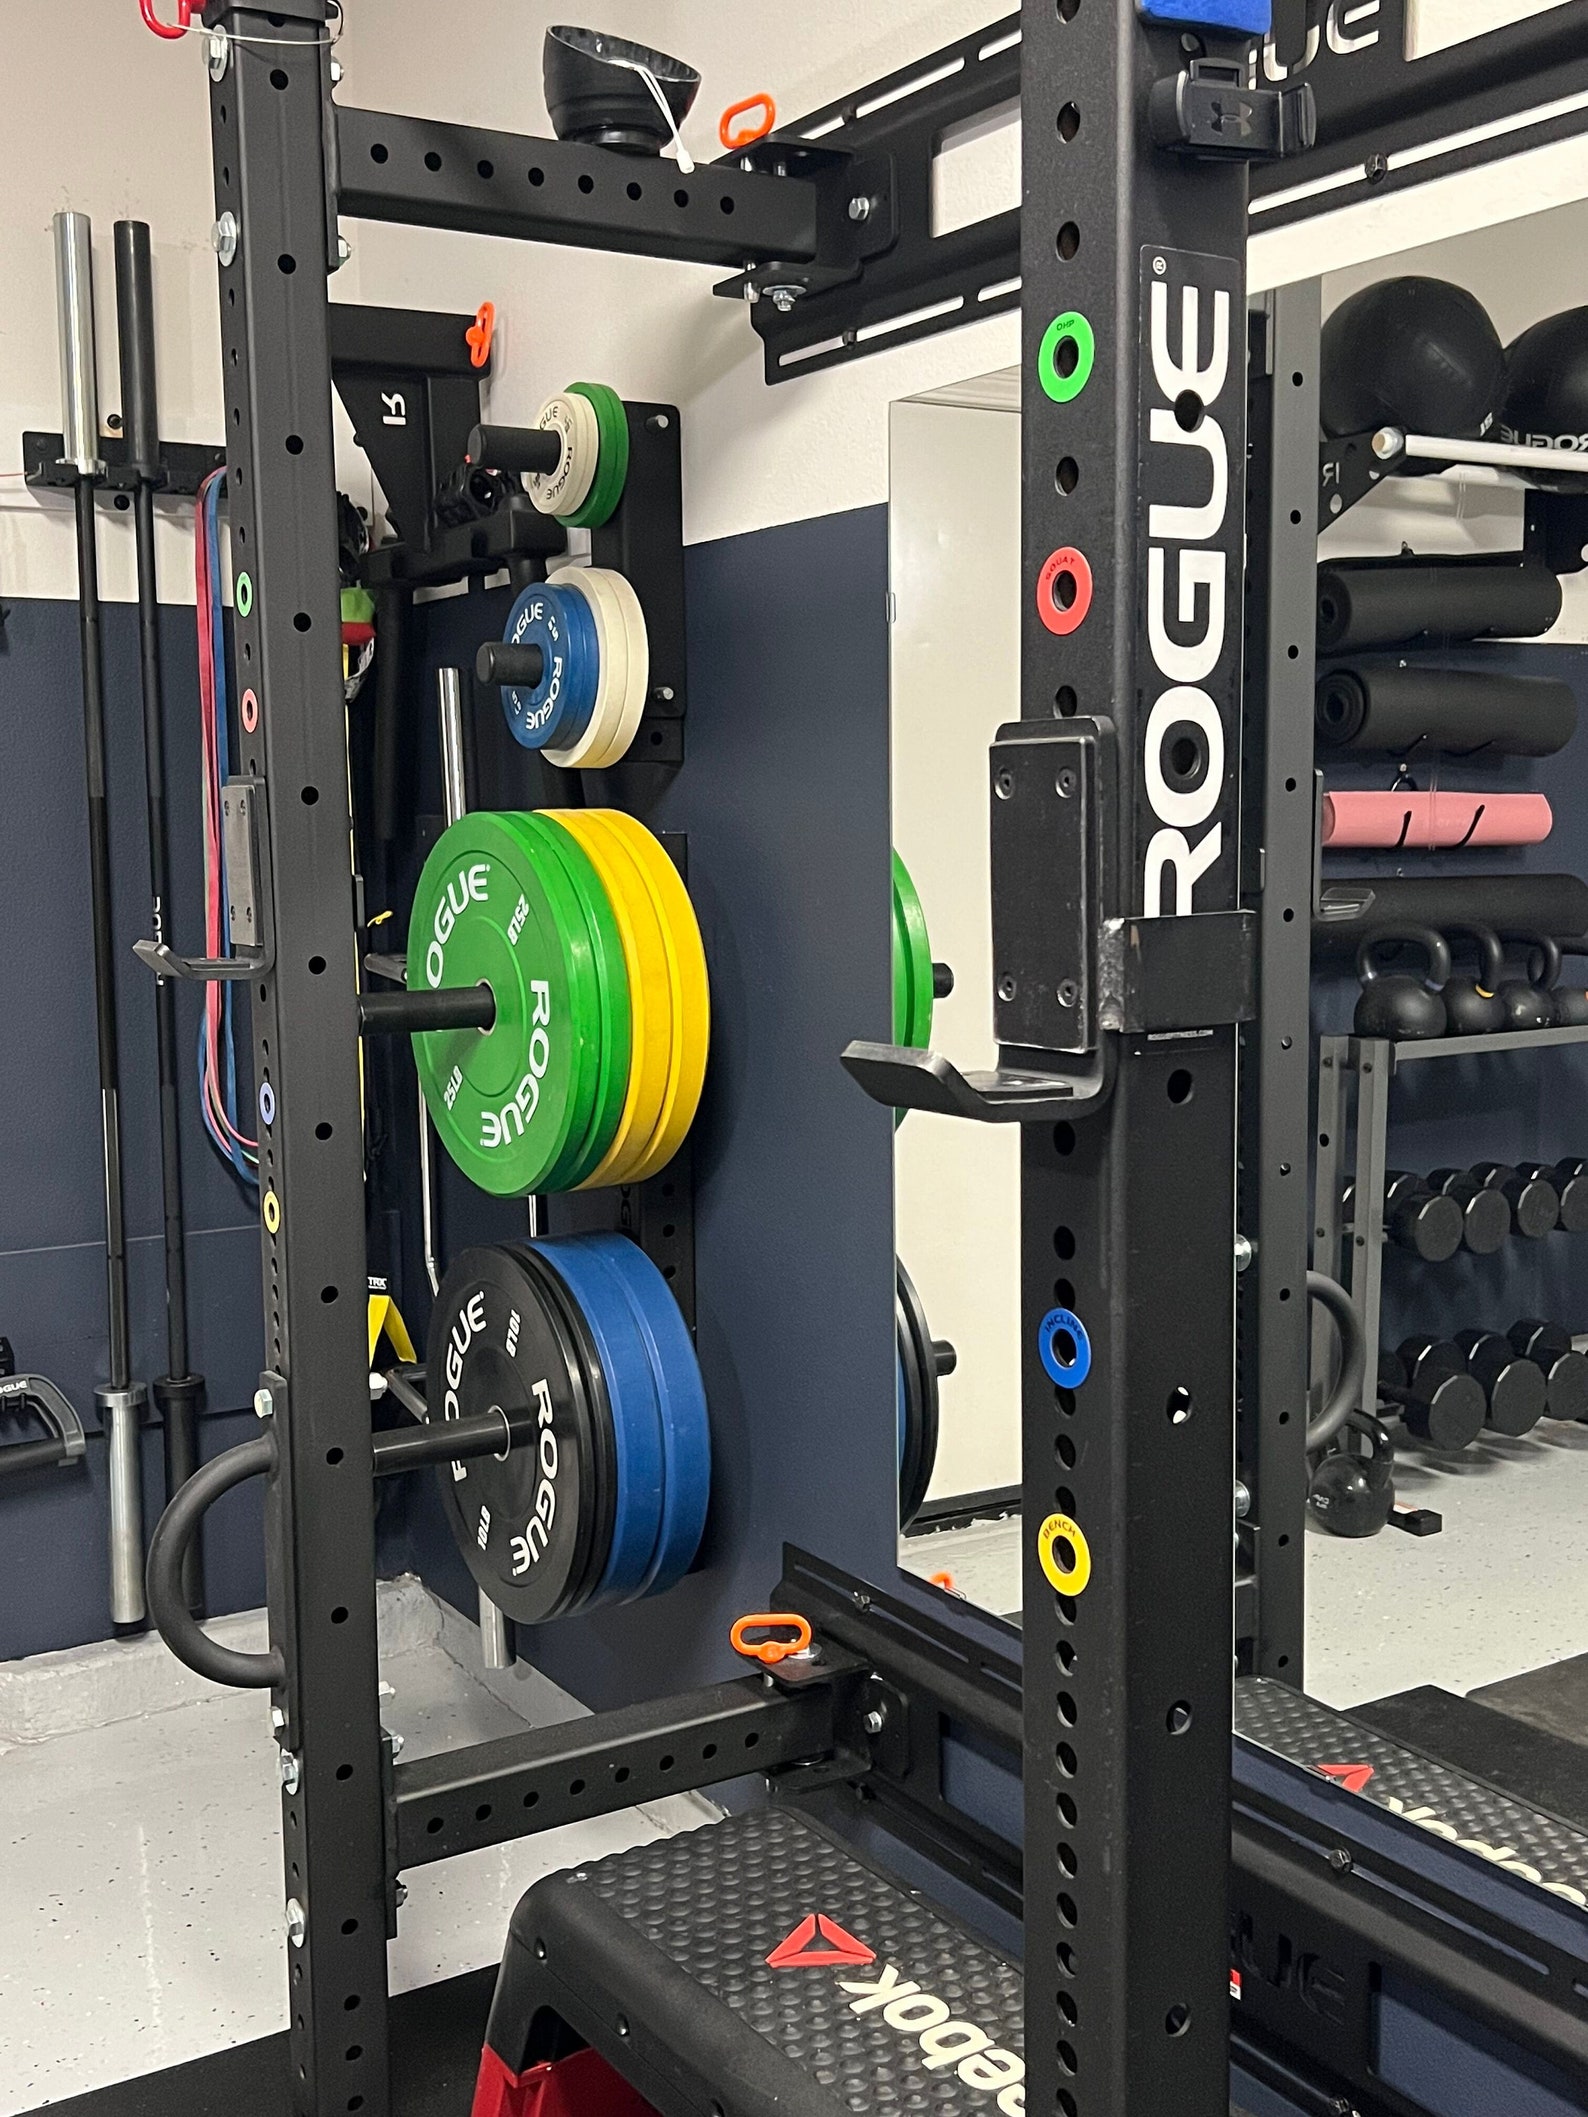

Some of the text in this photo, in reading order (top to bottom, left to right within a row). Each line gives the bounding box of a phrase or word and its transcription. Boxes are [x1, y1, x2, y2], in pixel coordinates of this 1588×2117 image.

[1056, 320, 1075, 331] OHP
[540, 406, 559, 430] GUE
[547, 447, 572, 500] ROGUE
[1045, 556, 1075, 580] SQUAT
[1144, 281, 1230, 917] ROGUE
[525, 656, 563, 730] ROGUE
[426, 864, 488, 989] OGUE
[507, 894, 530, 946] 25LB
[444, 1065, 463, 1111] 25LB
[480, 979, 550, 1148] ROGUE
[505, 1309, 521, 1358] 10LB
[1044, 1314, 1084, 1340] INCLINE
[510, 1378, 558, 1574] ROGUE
[477, 1505, 491, 1550] 10LB
[1043, 1519, 1076, 1540] BENCH
[835, 1964, 1025, 2117] ebok
